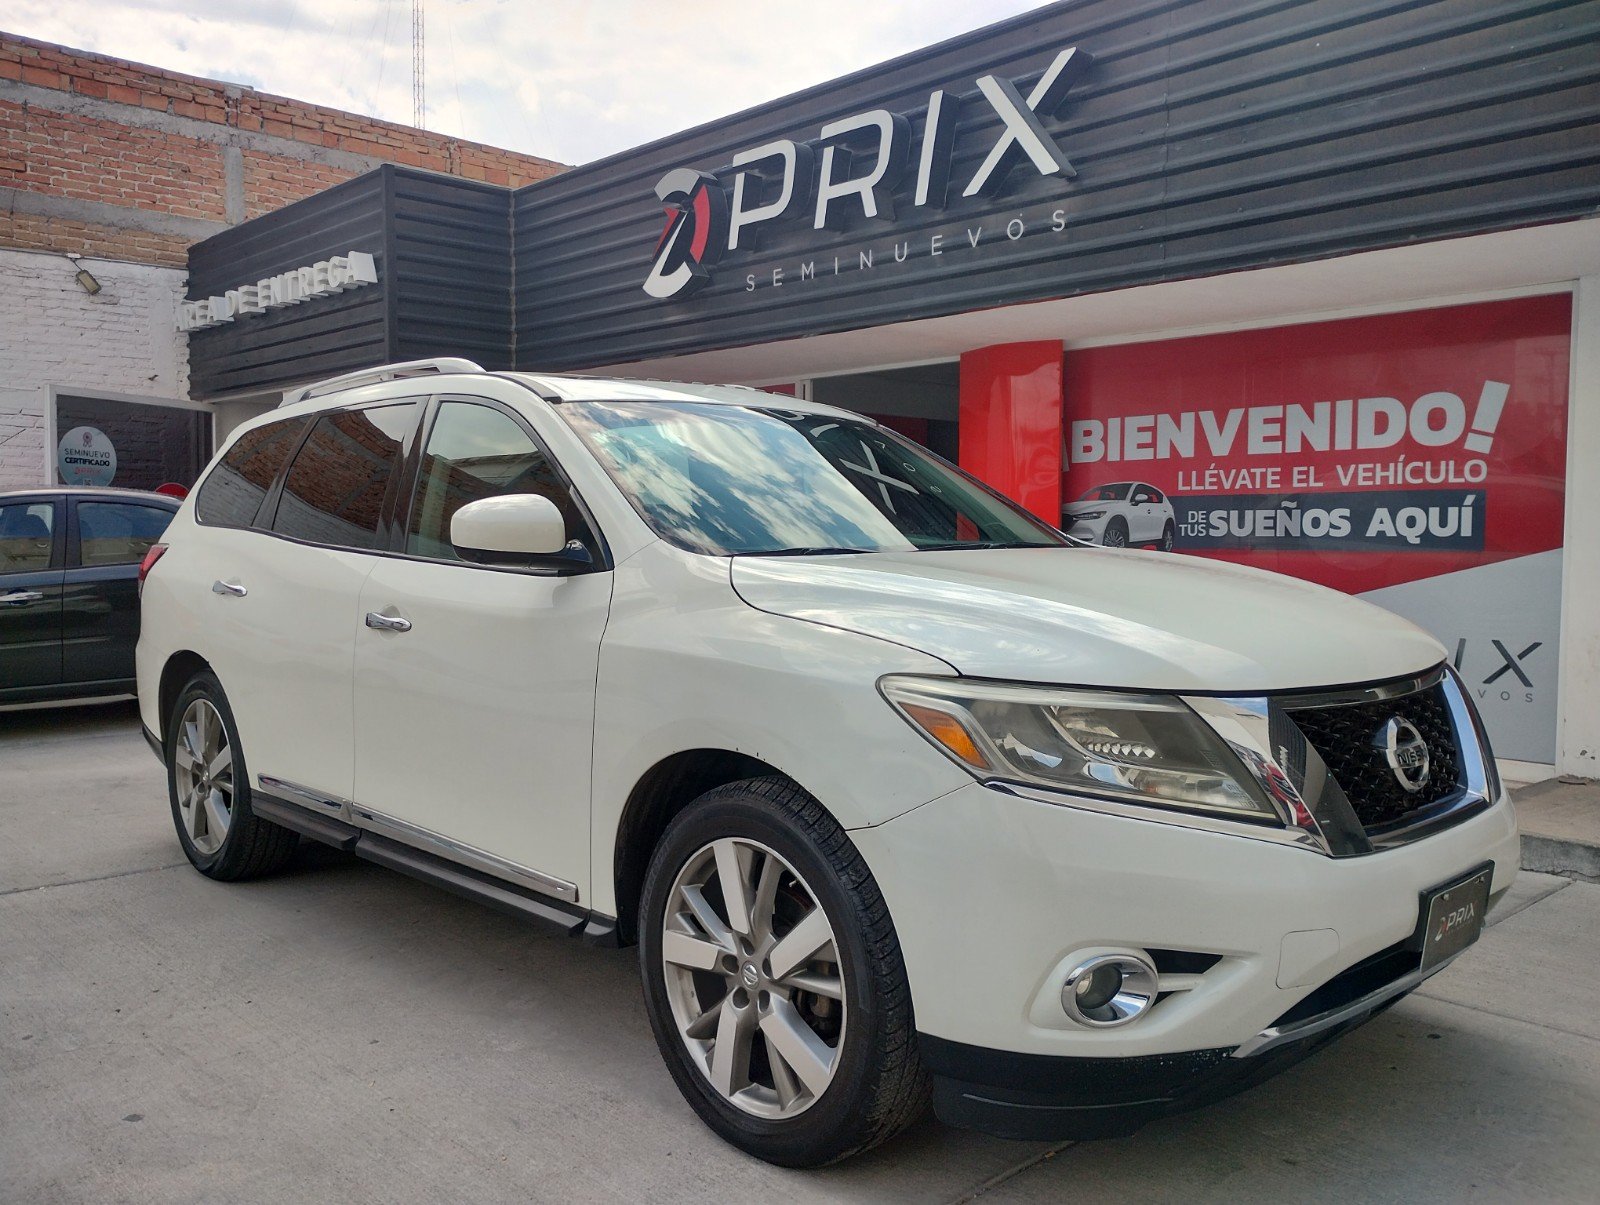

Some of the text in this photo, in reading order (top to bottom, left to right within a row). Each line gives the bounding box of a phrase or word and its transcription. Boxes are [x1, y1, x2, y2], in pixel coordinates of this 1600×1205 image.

[727, 46, 1080, 251] PRIX
[745, 209, 1067, 292] SEMINUEVOS
[257, 250, 378, 308] ENTREGA
[64, 448, 111, 459] SEMINUEVO
[64, 457, 111, 467] CERTIFICADO
[1177, 454, 1488, 491] LLÉVATE EL VEHÍCULO
[1178, 524, 1207, 537] TUS
[1187, 510, 1207, 524] DE
[1208, 494, 1477, 545] SUEÑOS AQUÍ
[1453, 637, 1544, 688] IX
